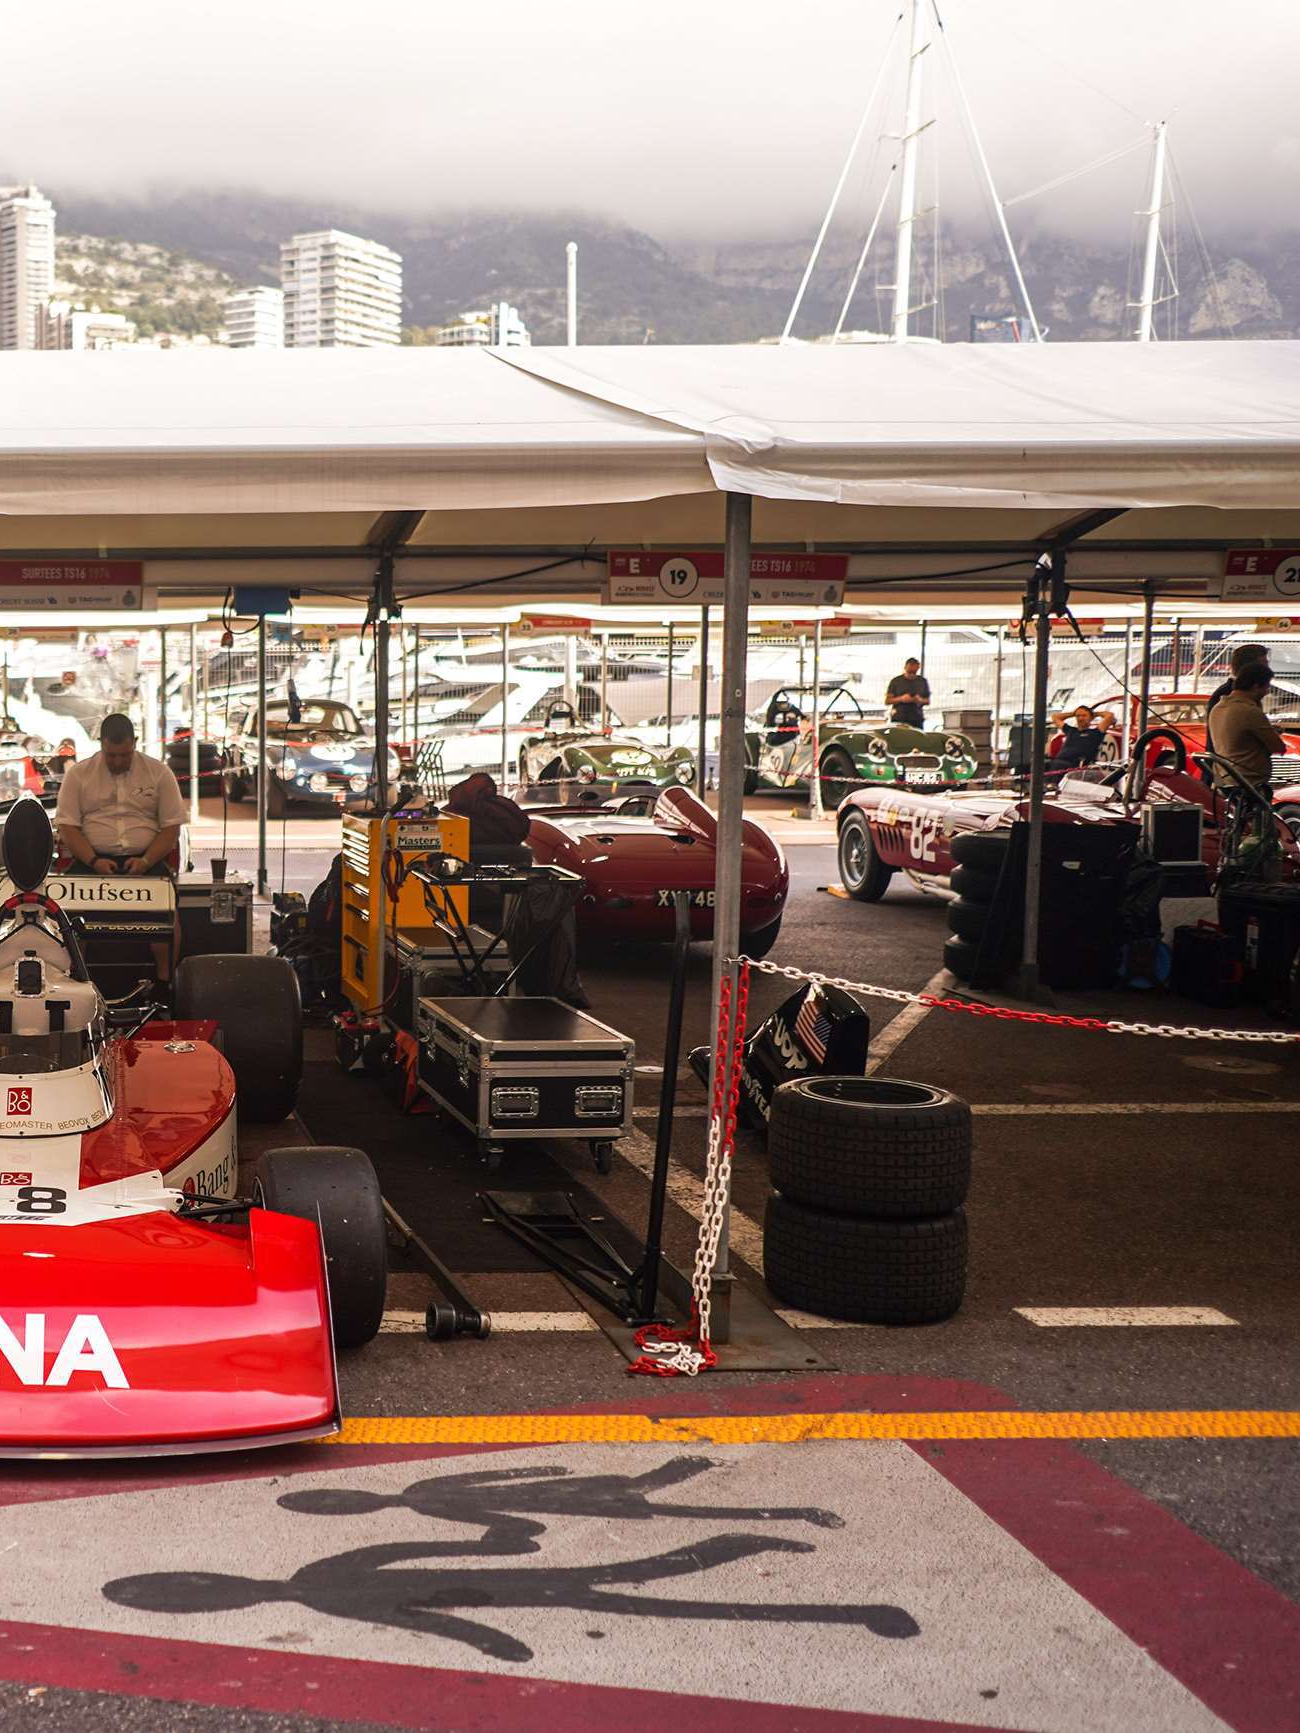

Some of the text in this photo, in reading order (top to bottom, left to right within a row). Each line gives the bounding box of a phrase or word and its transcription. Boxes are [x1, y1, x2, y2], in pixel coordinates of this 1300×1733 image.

[22, 567, 62, 579] SURTEES
[64, 567, 86, 579] TS16
[629, 558, 640, 574] E
[669, 569, 688, 585] 19
[397, 836, 440, 845] Masters
[910, 807, 941, 862] 82
[45, 881, 153, 902] Olufsen
[58, 1117, 90, 1130] BEOVOX
[196, 1153, 229, 1207] Bang
